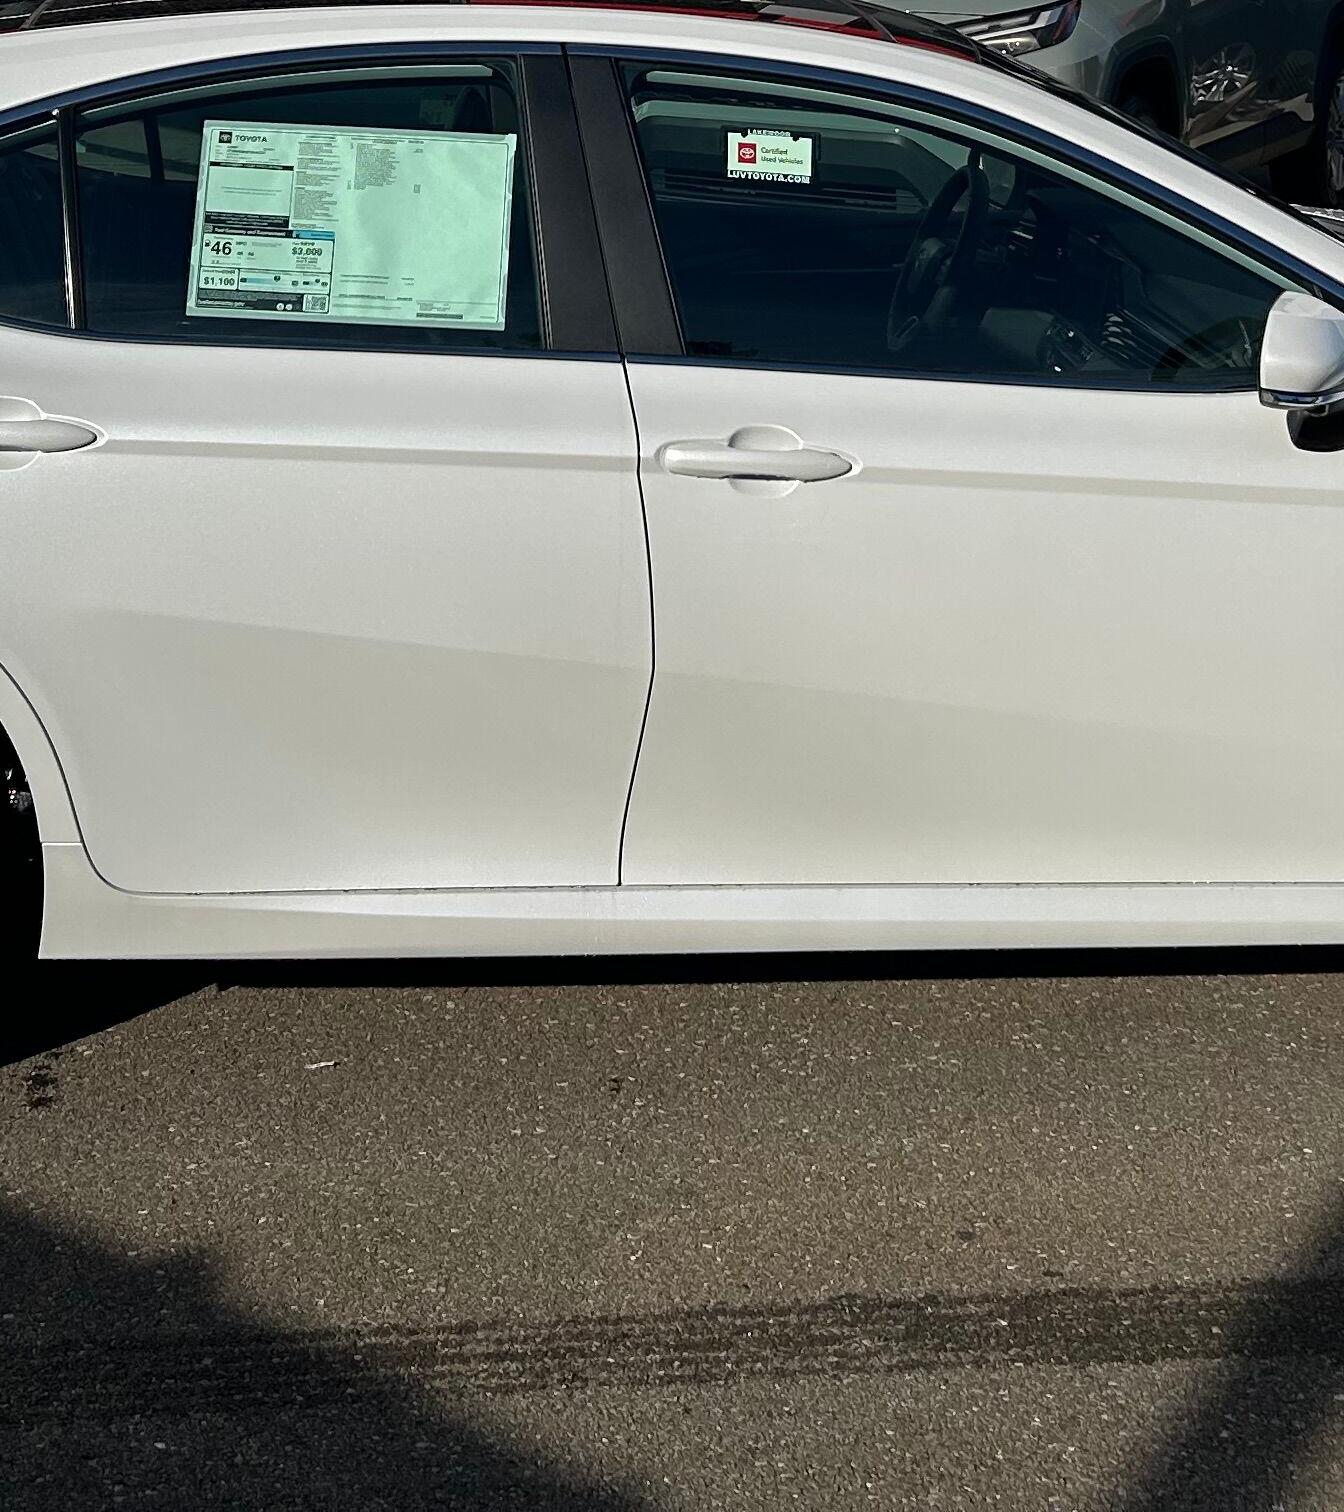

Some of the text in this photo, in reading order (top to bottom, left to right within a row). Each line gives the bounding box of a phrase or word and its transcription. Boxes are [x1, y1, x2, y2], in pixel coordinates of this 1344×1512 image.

[234, 134, 268, 143] TOYOTA
[760, 146, 788, 155] Certified
[760, 155, 804, 165] Used Vehicles
[727, 169, 811, 185] LUVTOYOTA.COM
[210, 240, 232, 255] 46
[203, 276, 235, 286] $1,100
